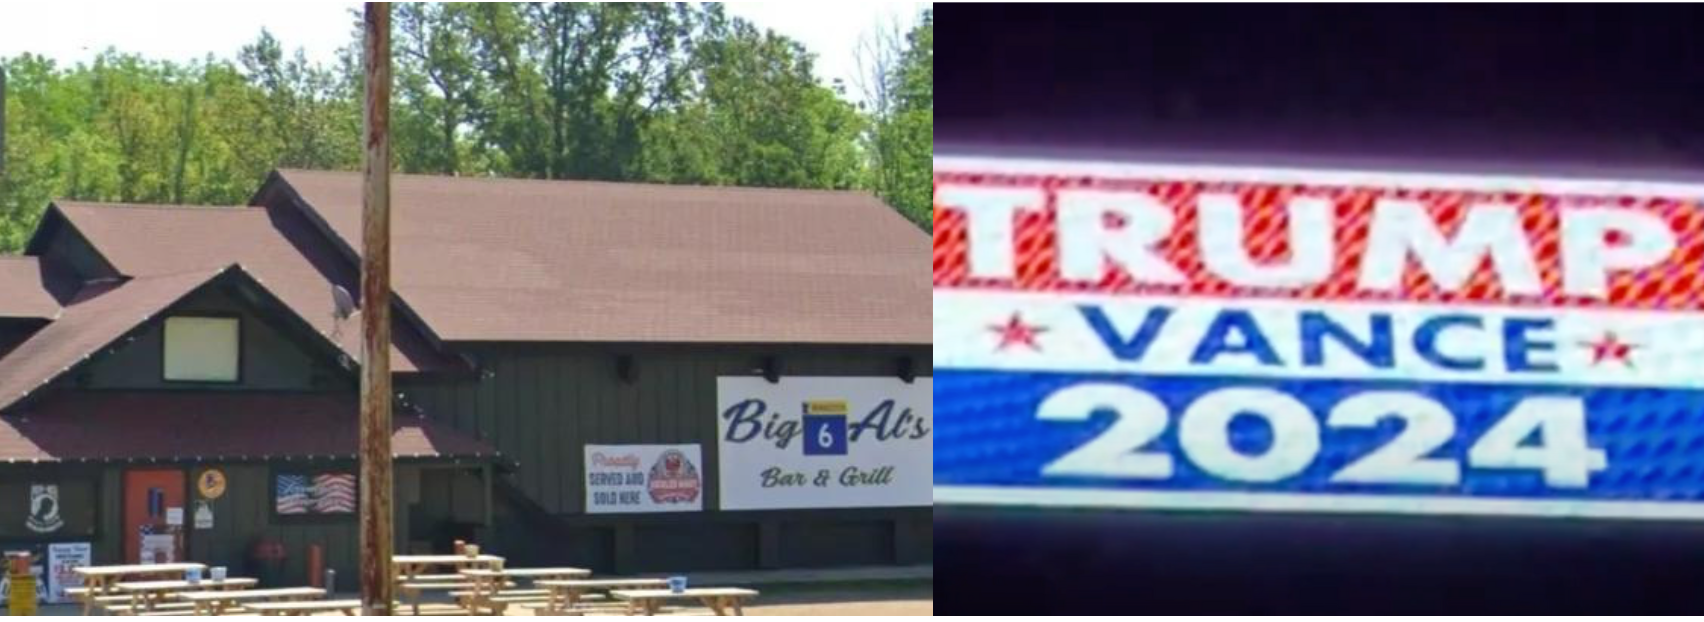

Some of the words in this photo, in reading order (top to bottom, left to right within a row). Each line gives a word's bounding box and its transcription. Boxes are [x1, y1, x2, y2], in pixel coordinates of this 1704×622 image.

[936, 185, 1678, 298] TRUMP
[1075, 304, 1561, 373] VANCE
[722, 398, 801, 449] Big
[817, 423, 834, 448] 6
[848, 399, 930, 442] Al's
[1035, 382, 1608, 489] 2024
[589, 472, 623, 486] SERVED
[625, 472, 645, 486] AND
[592, 452, 641, 471] Proudly
[760, 466, 808, 488] Bar
[813, 469, 830, 487] &
[839, 465, 895, 487] Grill
[593, 491, 617, 505] SOLD
[619, 490, 641, 505] HERE
